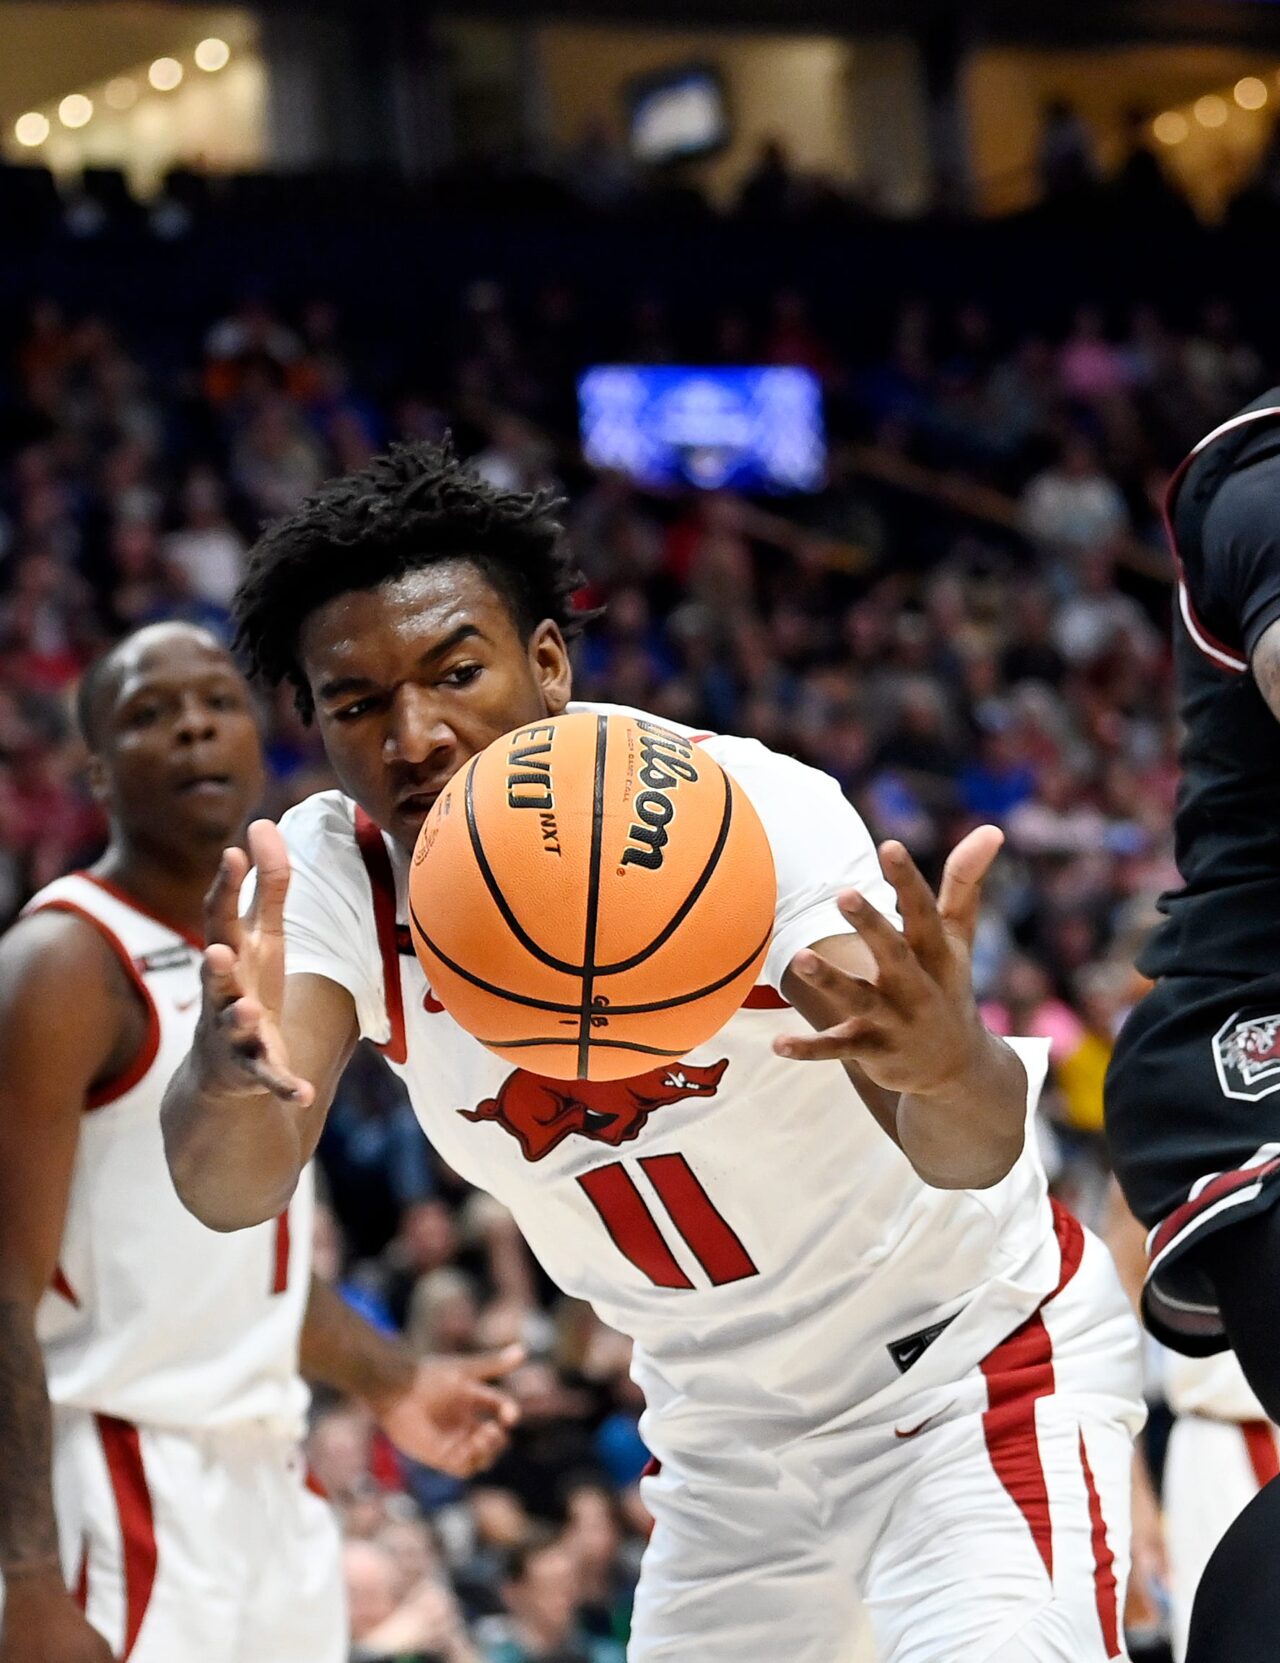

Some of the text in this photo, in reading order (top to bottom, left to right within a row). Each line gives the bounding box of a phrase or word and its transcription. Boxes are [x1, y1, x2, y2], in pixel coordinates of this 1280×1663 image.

[507, 725, 561, 858] EVO NXT
[575, 1152, 760, 1290] 11
